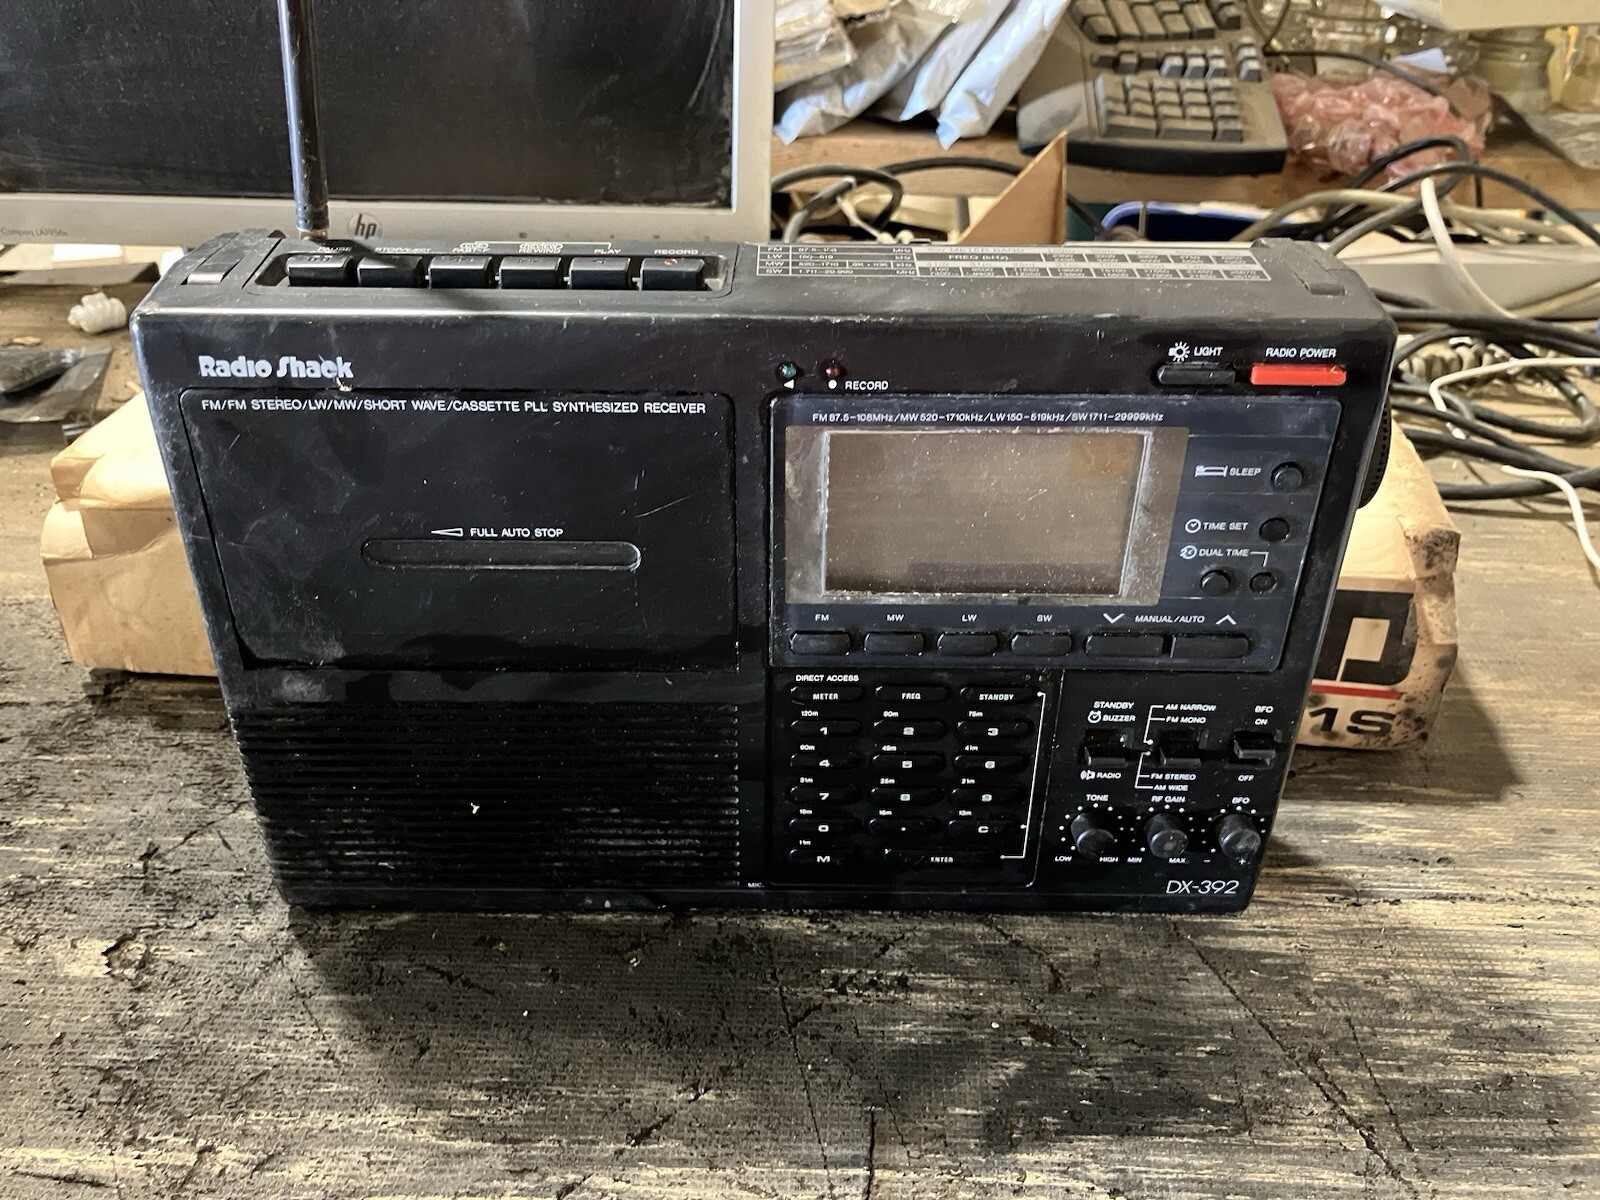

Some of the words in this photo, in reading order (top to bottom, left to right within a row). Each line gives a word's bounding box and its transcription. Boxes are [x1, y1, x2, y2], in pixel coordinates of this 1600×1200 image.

[354, 213, 378, 239] hp
[1194, 346, 1223, 356] LIGHT
[1266, 347, 1297, 358] RADIO
[1299, 347, 1337, 358] POWER
[198, 355, 272, 378] Radio
[276, 356, 354, 378] Shack
[845, 381, 889, 391] RECORD
[202, 399, 247, 411] FM/FM
[251, 399, 408, 412] STEREO/LW/MW/SHORT
[411, 400, 521, 413] WAVE/CASSETTE
[524, 401, 549, 413] PLL
[552, 401, 639, 414] SYNTHESIZED
[644, 402, 707, 414] RECEIVER
[812, 413, 828, 422] FM
[1229, 467, 1262, 477] SLEEP
[1203, 521, 1226, 531] TIME
[1228, 521, 1249, 531] SET
[470, 528, 498, 538] FULL
[501, 527, 531, 538] AUTO
[534, 528, 564, 538] STOP
[1198, 548, 1224, 557] DUAL
[1225, 548, 1250, 557] TIME
[886, 614, 905, 622] MW
[962, 614, 978, 622] LW
[1036, 614, 1052, 622] SW
[1134, 614, 1205, 624] MANUAL/AUTO
[795, 674, 824, 682] DIRECT
[901, 692, 921, 700] FREQ
[979, 693, 1014, 701] STANDBY
[1093, 701, 1134, 709] STANDBY
[1165, 703, 1178, 711] AM
[1179, 703, 1217, 712] NARROW
[1255, 705, 1274, 713] BFO
[1102, 714, 1136, 722] BUZZER
[819, 726, 828, 735] 1
[902, 727, 915, 736] 2
[987, 727, 999, 736] 3
[818, 759, 831, 768] 4
[1164, 773, 1197, 781] STEREO
[1238, 774, 1254, 782] OFF
[818, 792, 830, 801] 7
[1086, 794, 1109, 802] TONE
[1151, 795, 1163, 803] RF
[1164, 795, 1186, 804] GAIN
[1231, 797, 1250, 805] BFO
[977, 825, 989, 834] C
[816, 855, 831, 863] M
[1054, 855, 1073, 863] LOW
[1165, 879, 1240, 895] DX-392
